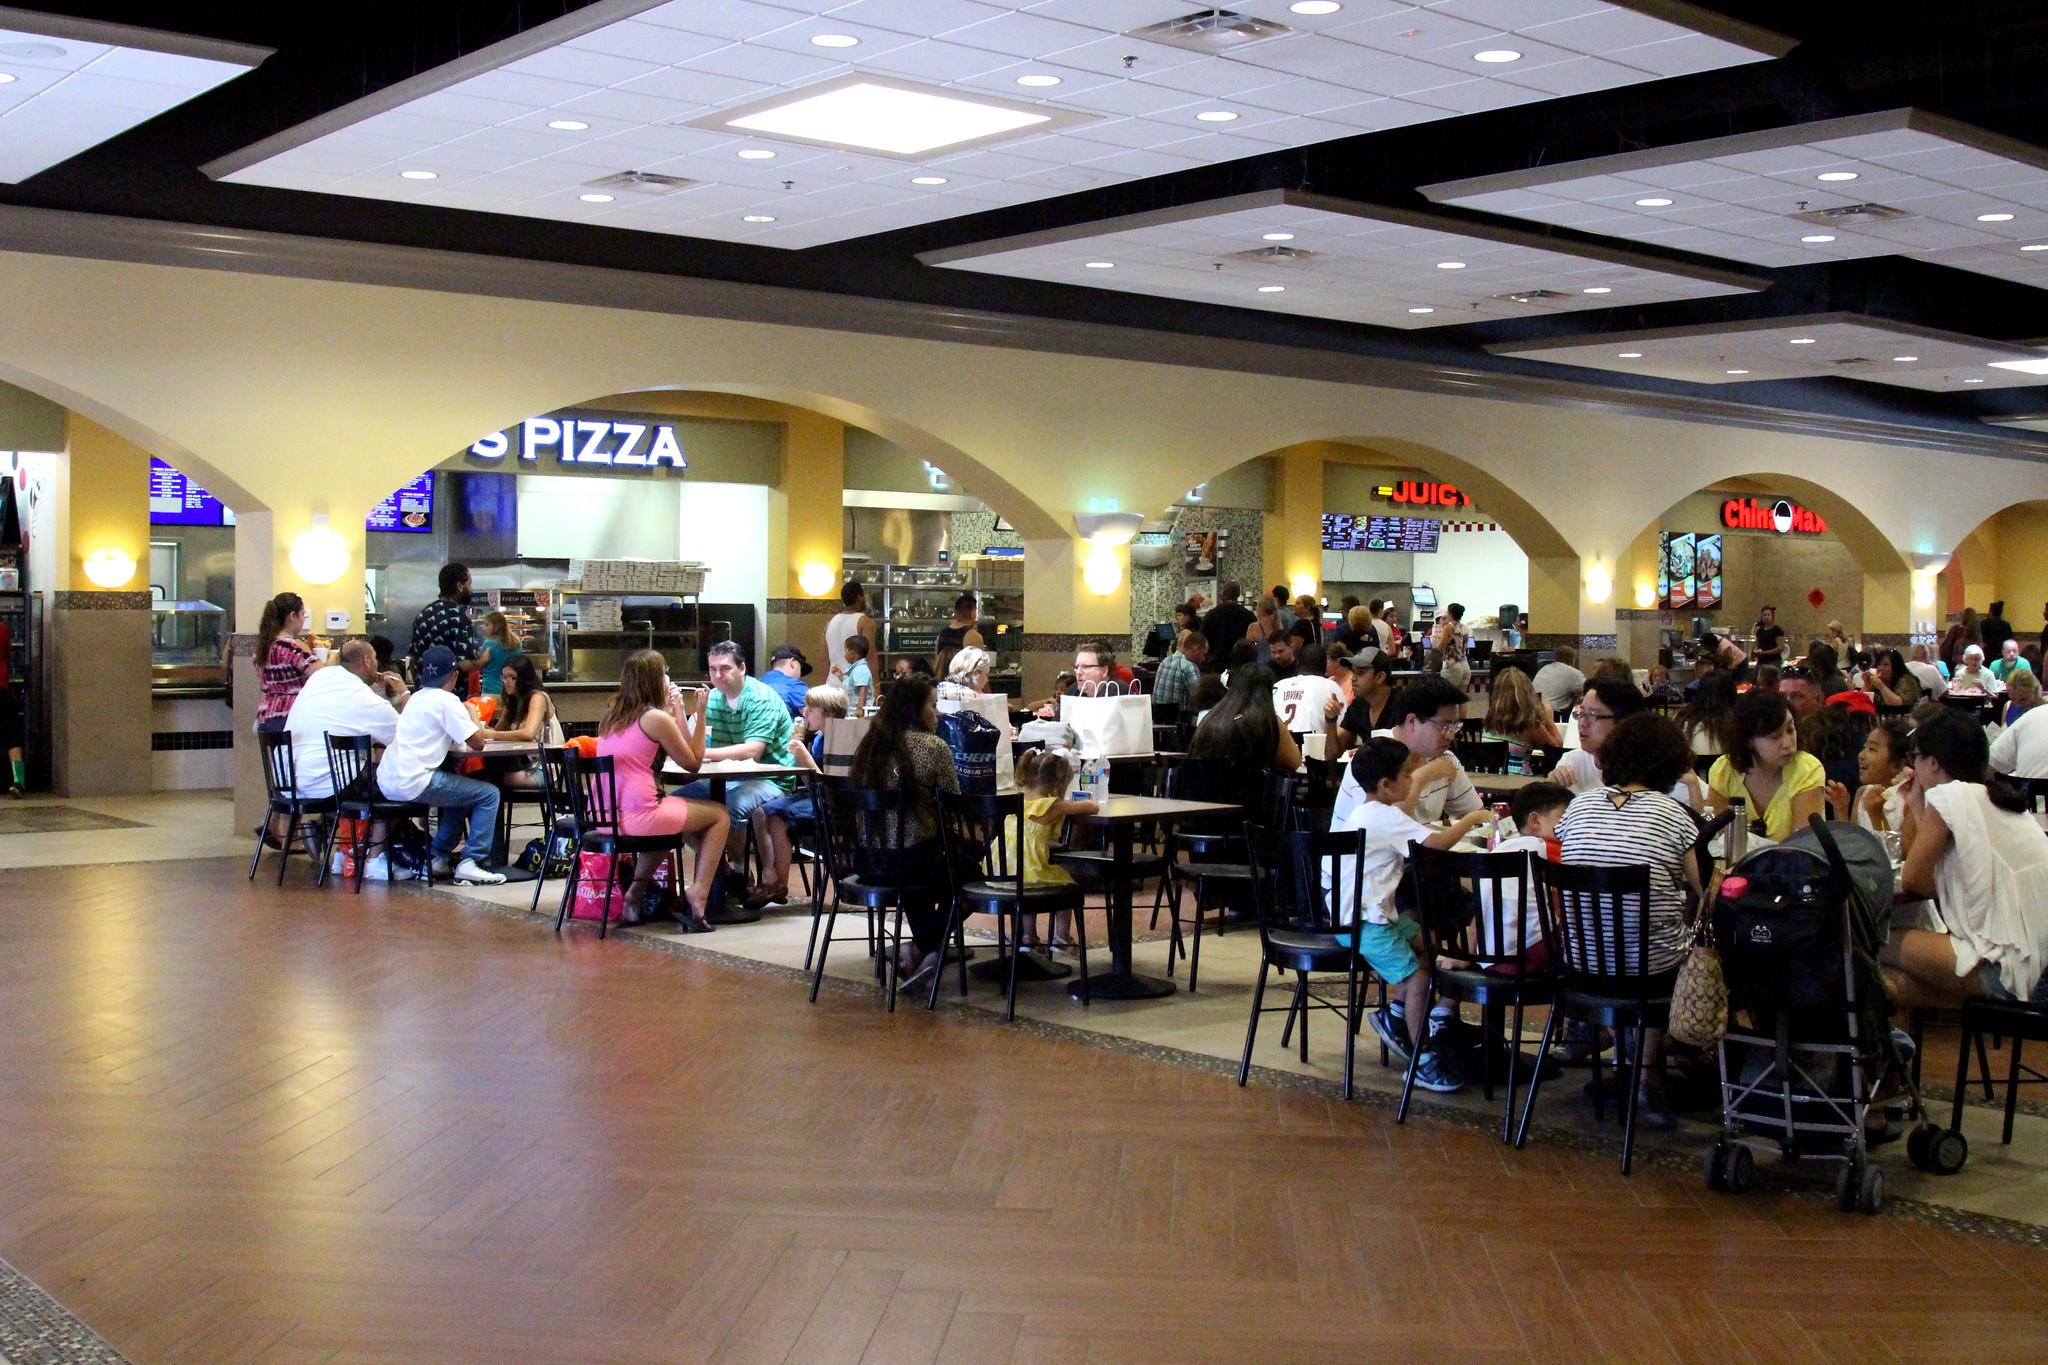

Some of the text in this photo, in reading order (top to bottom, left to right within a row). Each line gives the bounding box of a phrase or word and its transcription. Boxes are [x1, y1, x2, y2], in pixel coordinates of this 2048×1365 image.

[520, 417, 688, 468] PIZZA
[1724, 498, 1776, 530] China
[1283, 690, 1304, 701] IRVING
[1284, 703, 1297, 727] 2
